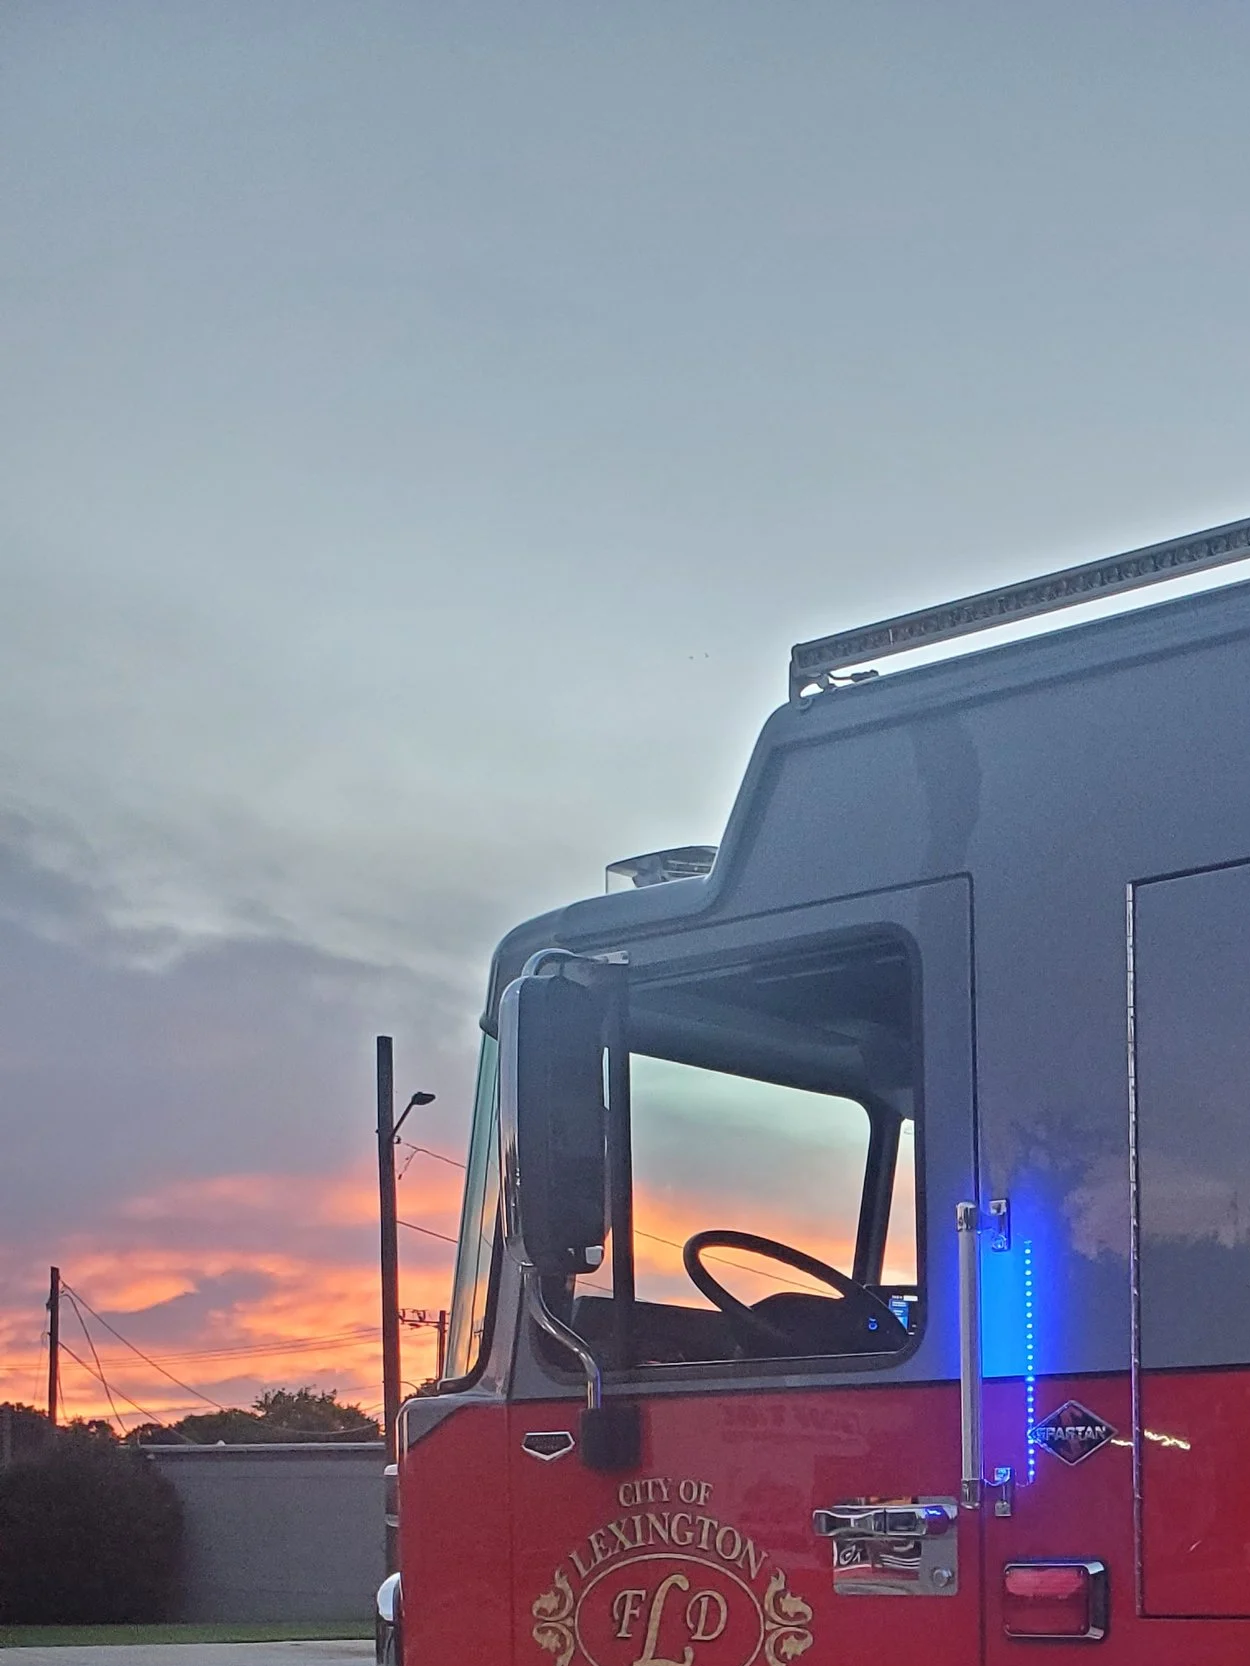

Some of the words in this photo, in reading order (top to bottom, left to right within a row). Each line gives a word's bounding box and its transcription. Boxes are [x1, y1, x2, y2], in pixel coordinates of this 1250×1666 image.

[618, 1477, 672, 1507] CITY
[678, 1479, 714, 1507] OF
[568, 1511, 768, 1580] LEXINGTON
